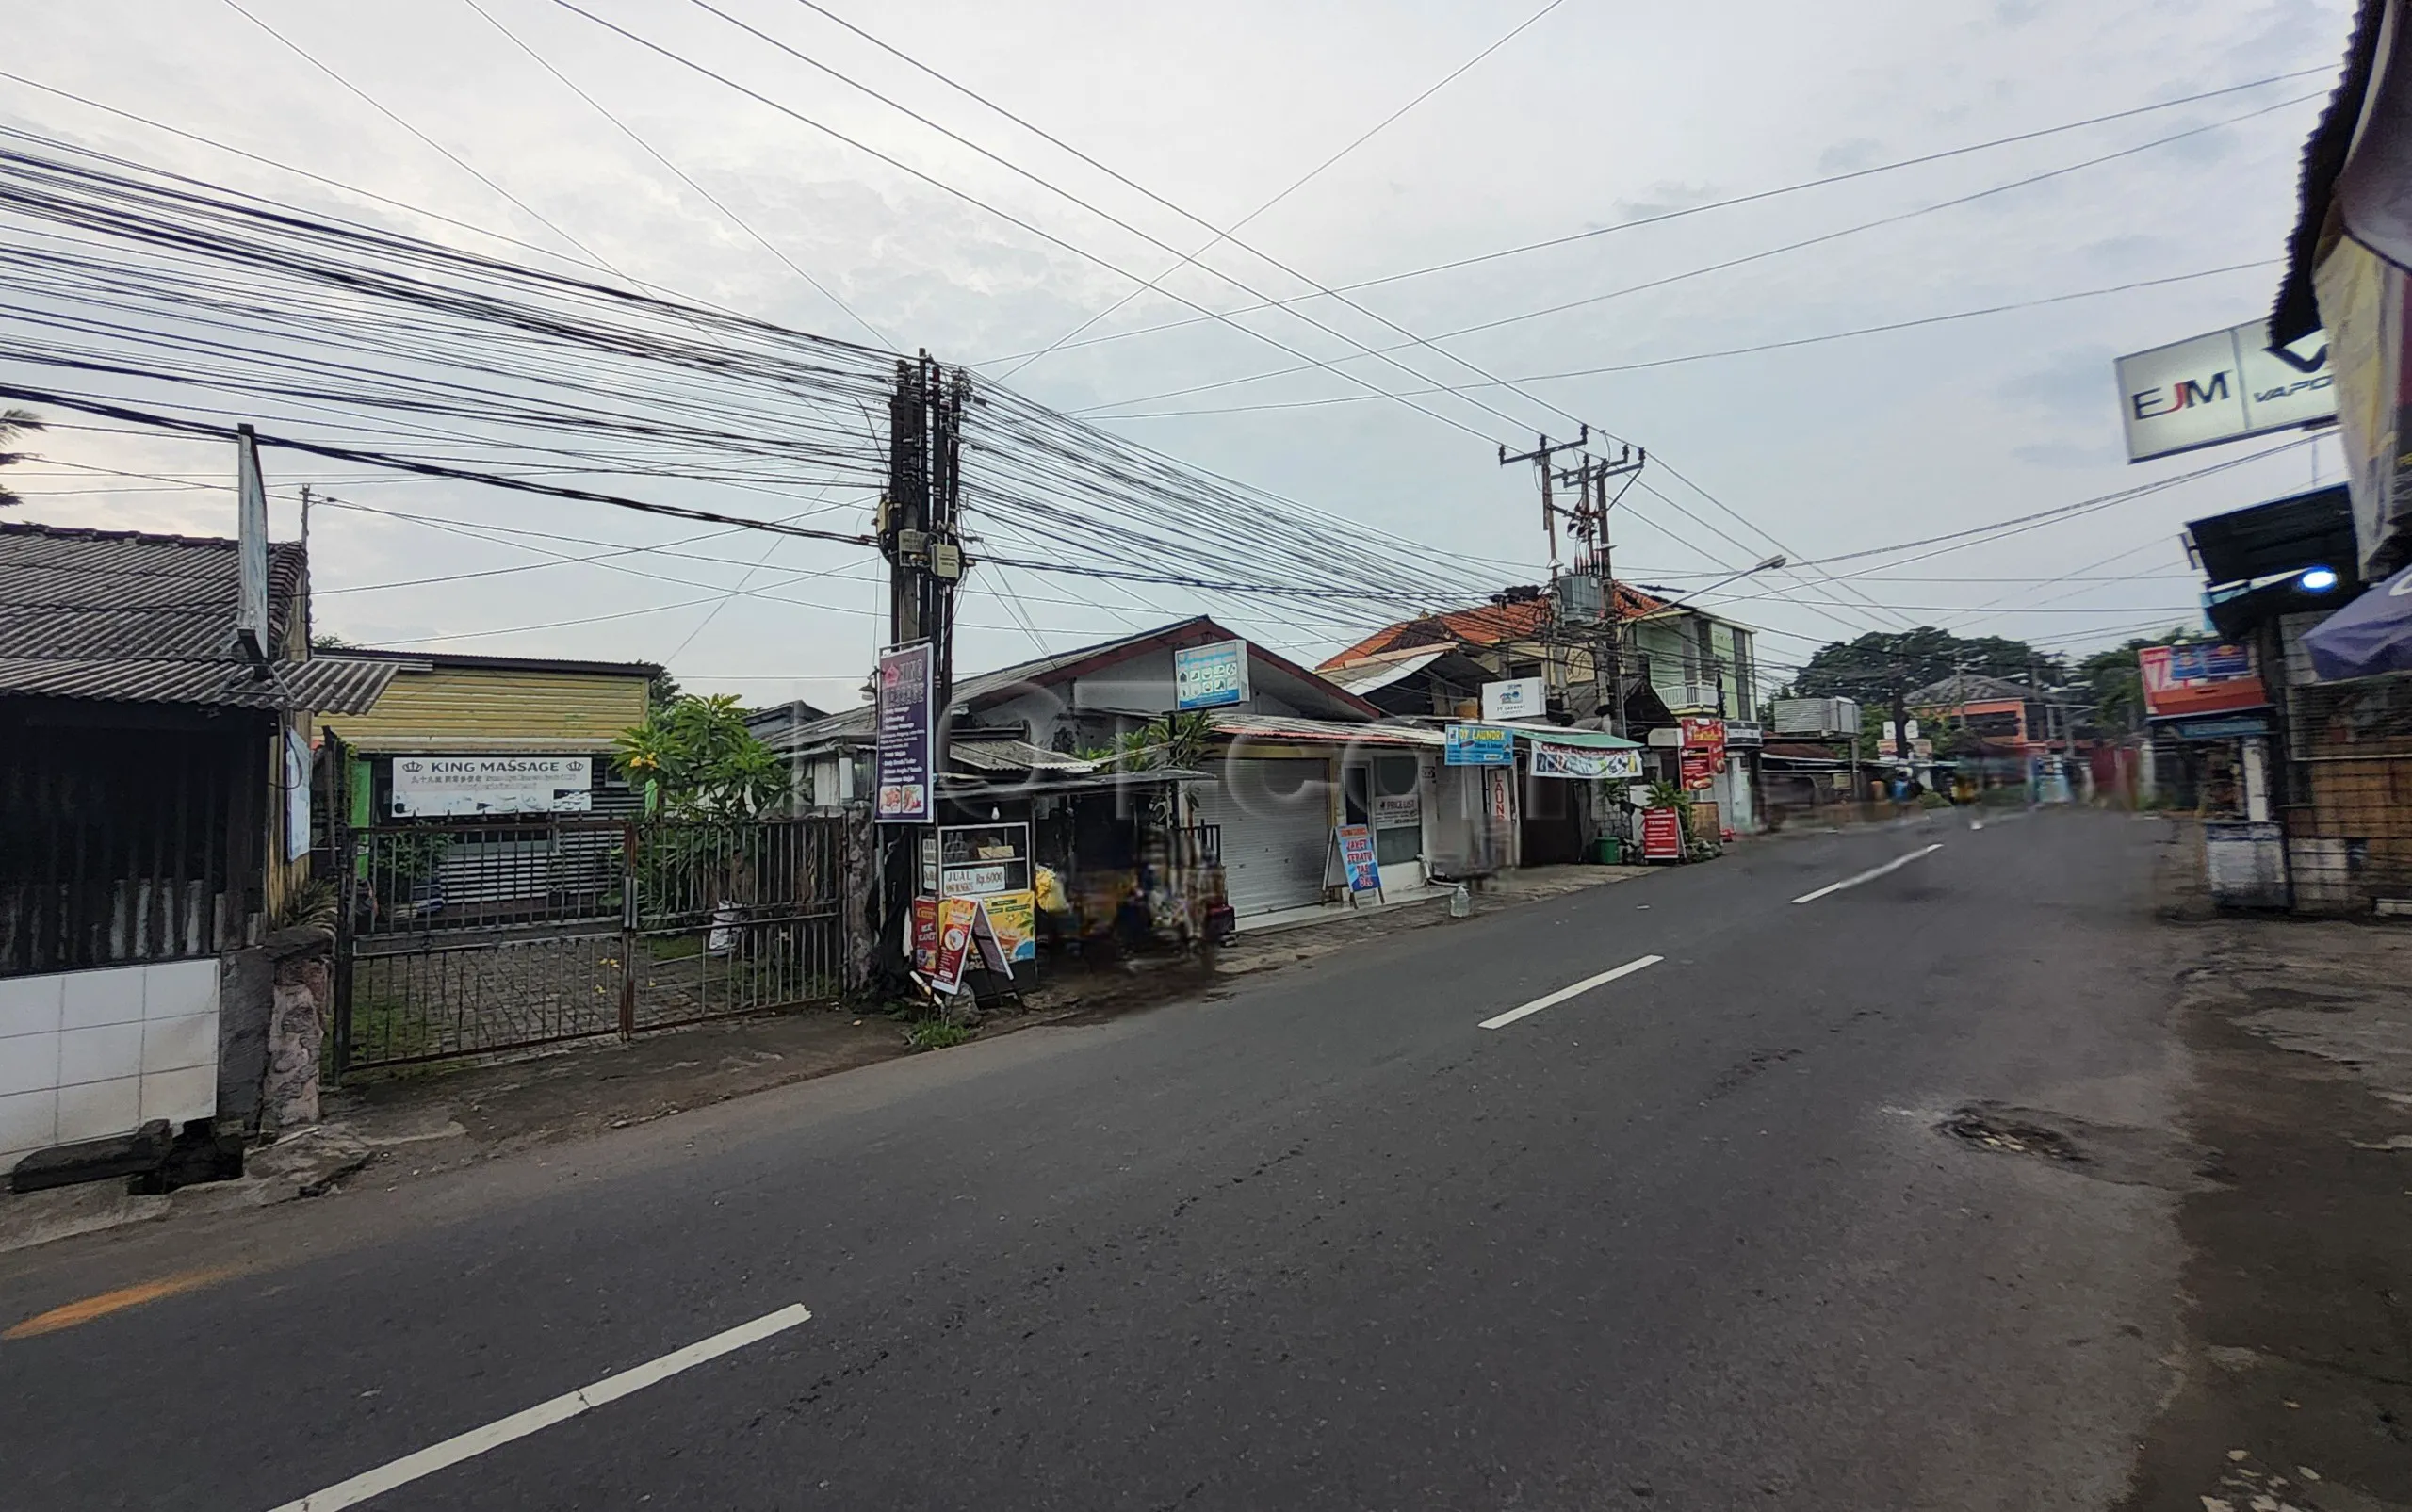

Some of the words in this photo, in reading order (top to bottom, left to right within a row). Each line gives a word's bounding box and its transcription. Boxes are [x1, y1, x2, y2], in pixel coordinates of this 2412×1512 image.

[2130, 369, 2233, 420] EJM
[1472, 728, 1505, 740] LAUNDRY
[431, 761, 475, 773] KING
[480, 760, 560, 772] MASSAGE
[948, 870, 972, 882] JUAL
